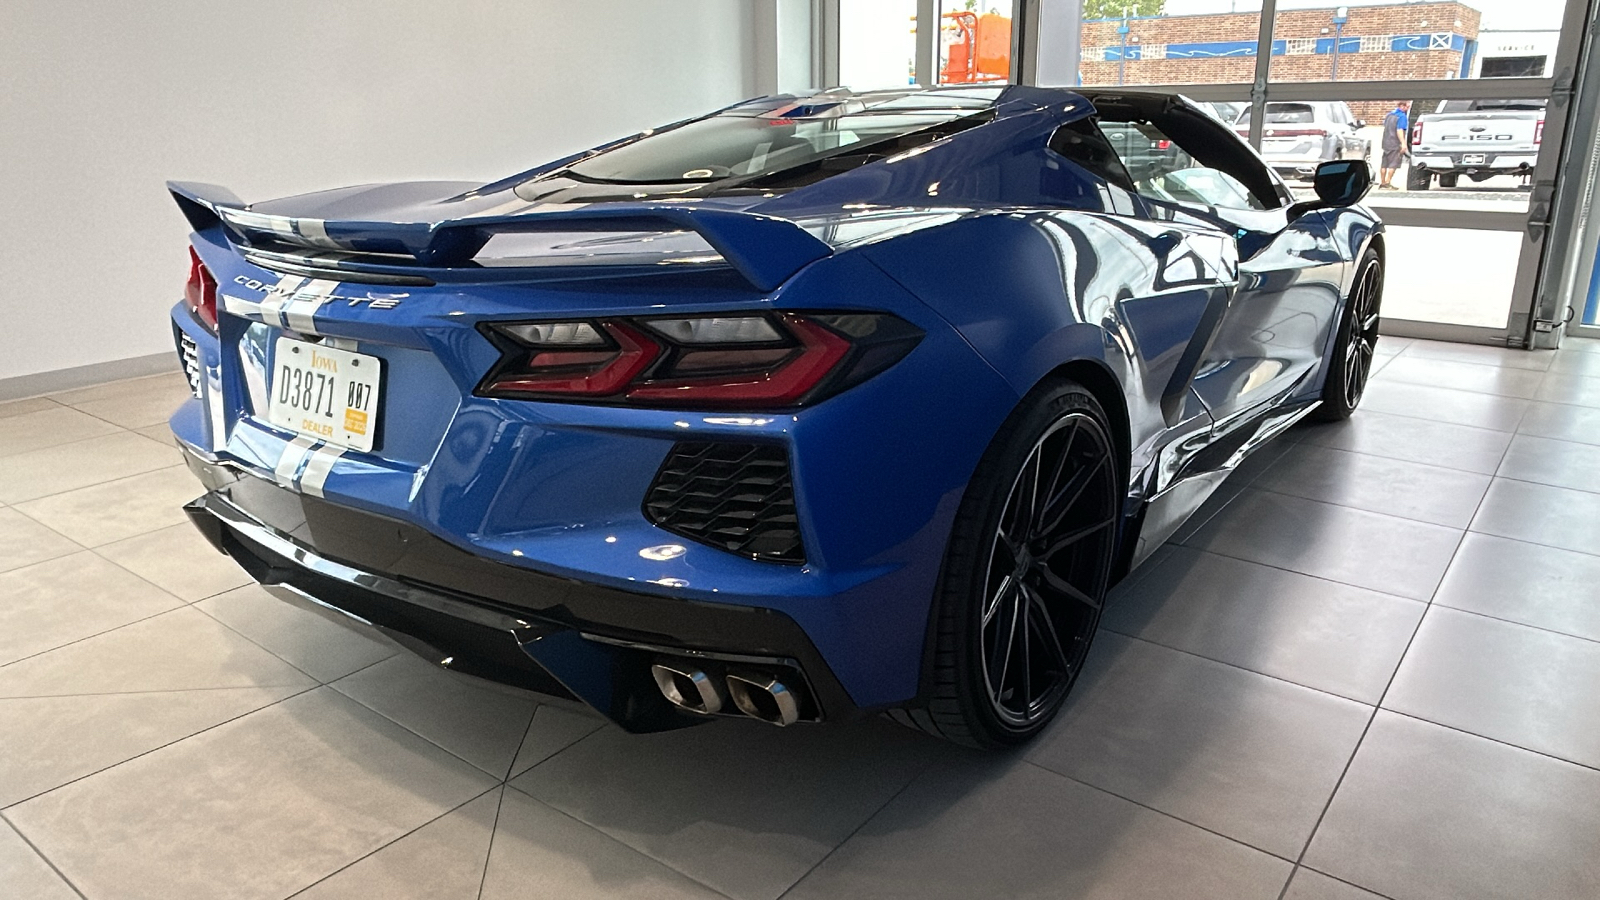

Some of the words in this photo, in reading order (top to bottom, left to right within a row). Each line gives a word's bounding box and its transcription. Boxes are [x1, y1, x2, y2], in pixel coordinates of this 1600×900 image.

[233, 275, 401, 309] CORVETTE
[280, 365, 334, 418] D3871
[302, 419, 334, 437] DEALER
